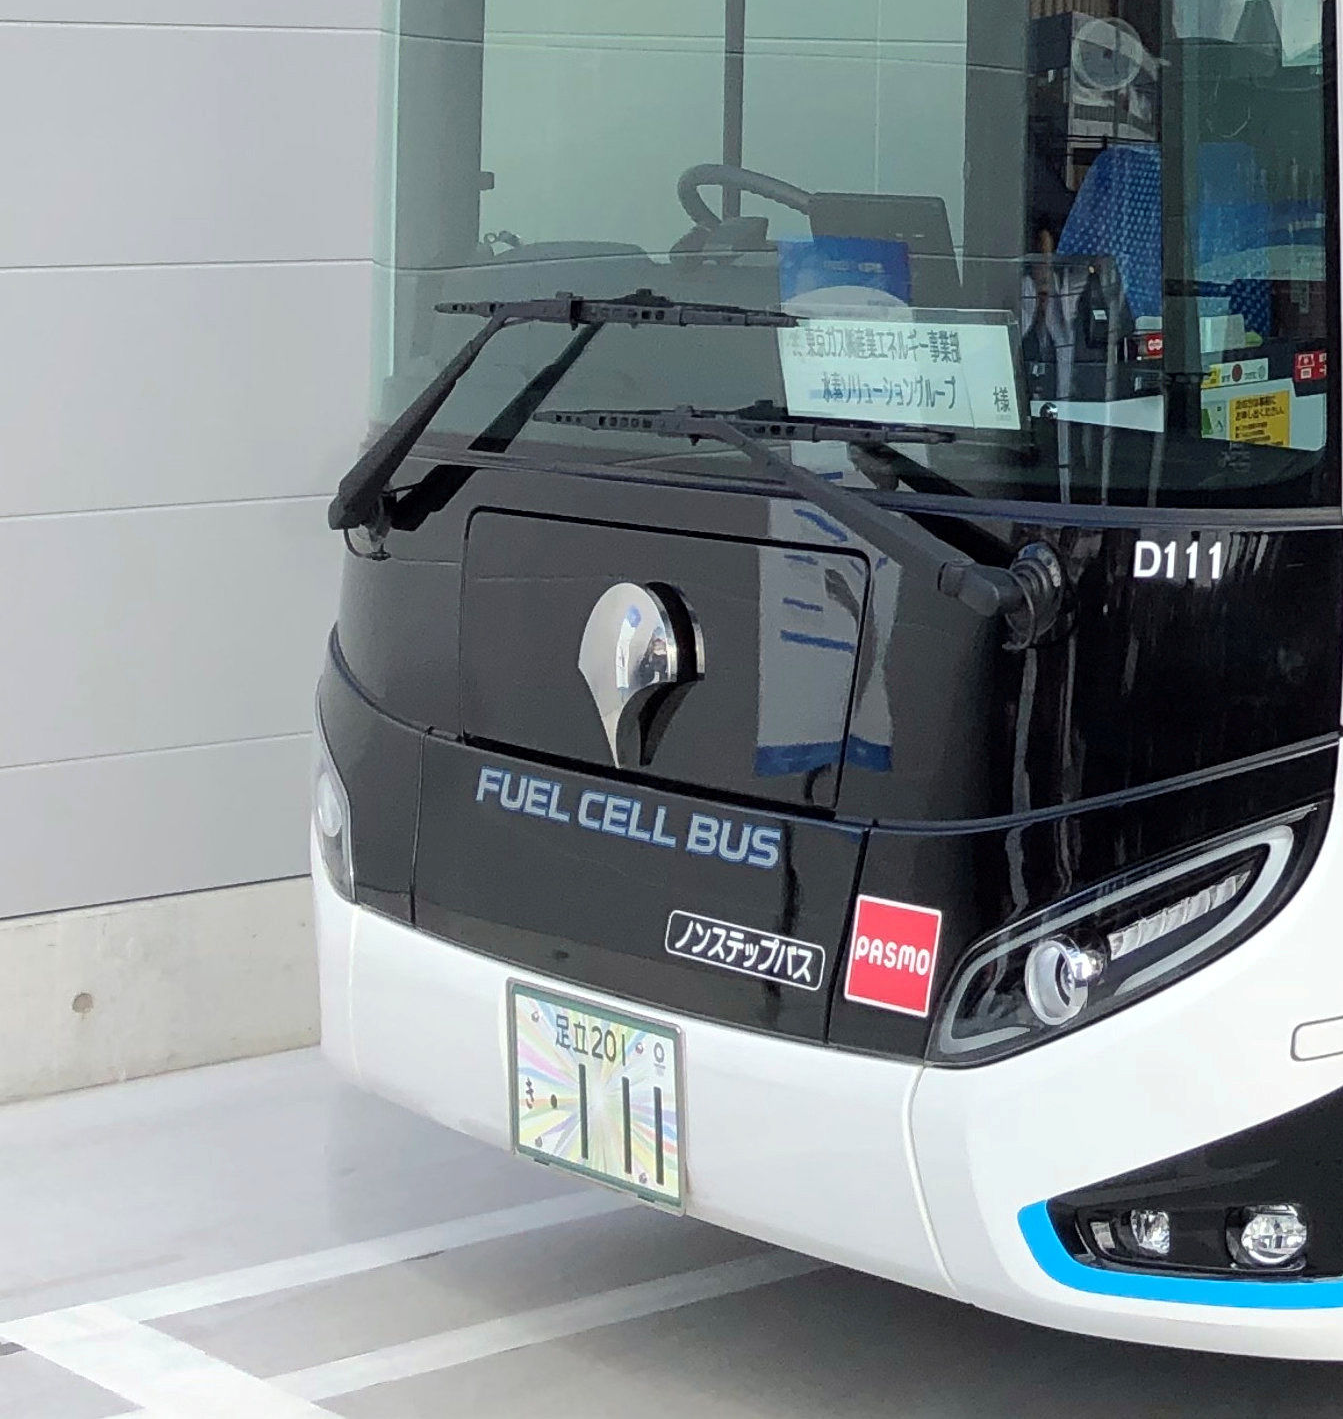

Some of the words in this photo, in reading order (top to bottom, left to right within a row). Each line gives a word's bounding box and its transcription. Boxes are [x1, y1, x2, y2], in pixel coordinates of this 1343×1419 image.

[1132, 540, 1223, 579] D111
[475, 765, 571, 823] FUEL
[577, 788, 677, 848] CELL
[685, 811, 783, 869] BUS
[674, 919, 813, 982] ノンステップバス
[854, 935, 931, 976] PASMO
